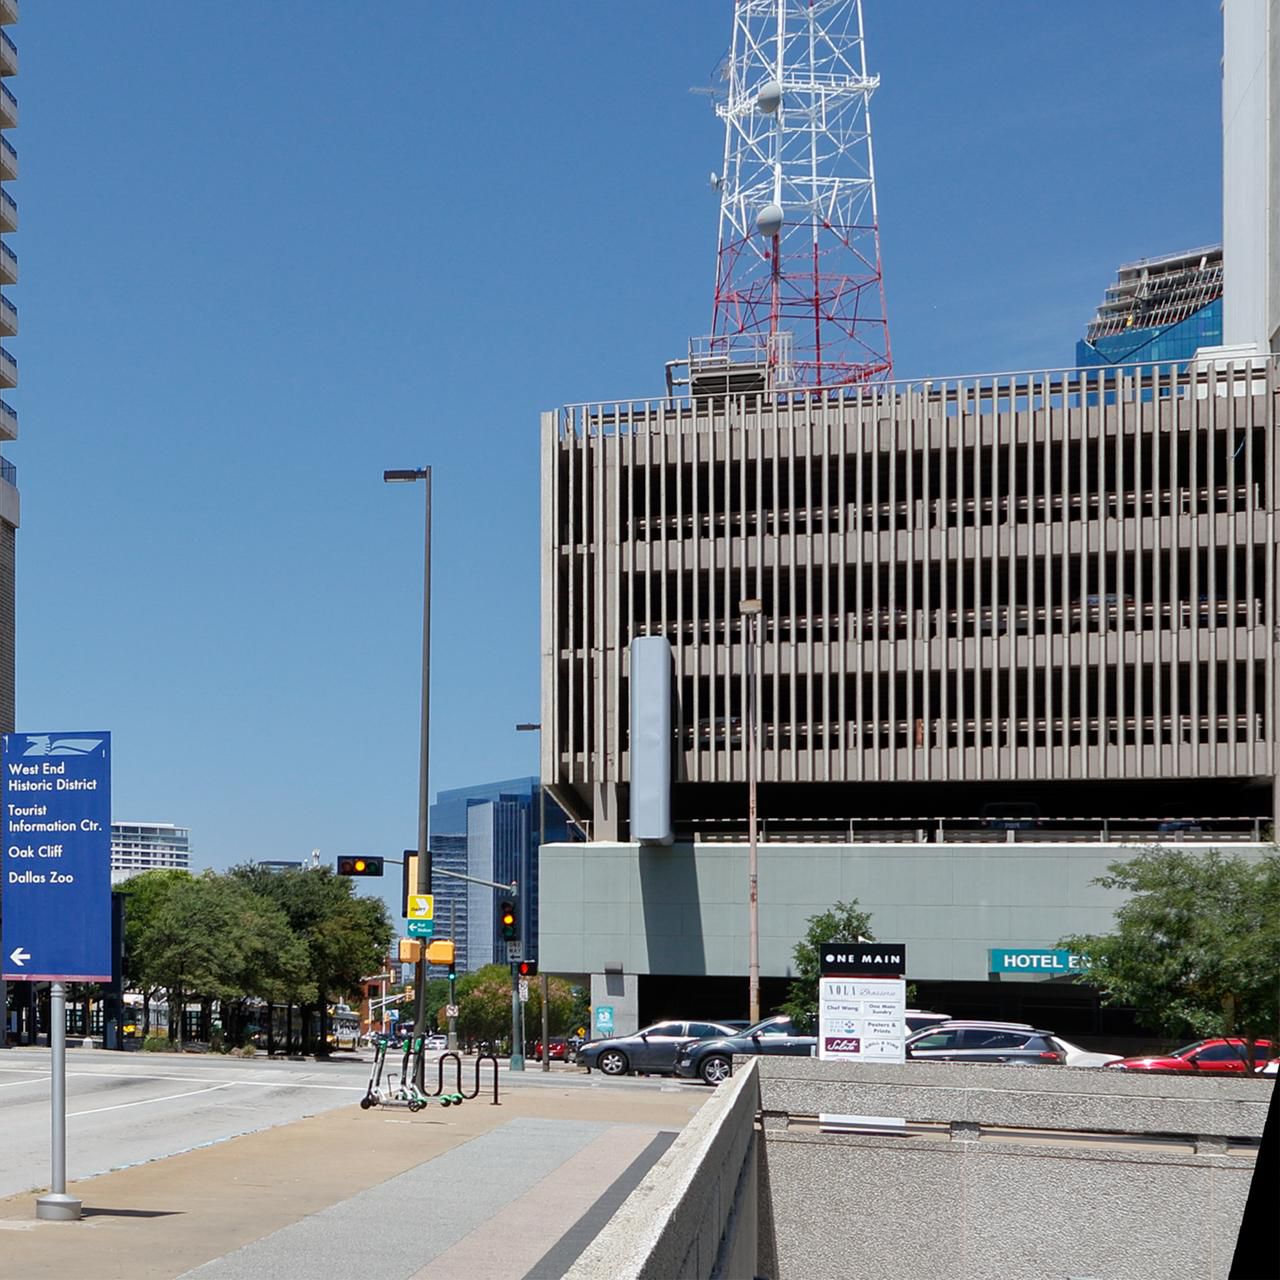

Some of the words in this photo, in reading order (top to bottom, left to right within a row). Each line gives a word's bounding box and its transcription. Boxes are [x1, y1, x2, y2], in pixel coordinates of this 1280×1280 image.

[8, 763, 39, 775] West
[42, 761, 65, 775] End
[8, 779, 53, 791] Historic
[56, 778, 97, 790] District
[8, 804, 47, 816] Tourist
[9, 819, 77, 832] Information
[80, 819, 102, 831] Ctr.
[8, 845, 35, 858] Oak
[38, 845, 63, 858] Cliff
[8, 870, 46, 883] Dallas
[49, 871, 74, 883] Zoo
[825, 954, 855, 963] ONE
[861, 954, 900, 964] MAIN
[1004, 954, 1064, 968] HOTEL
